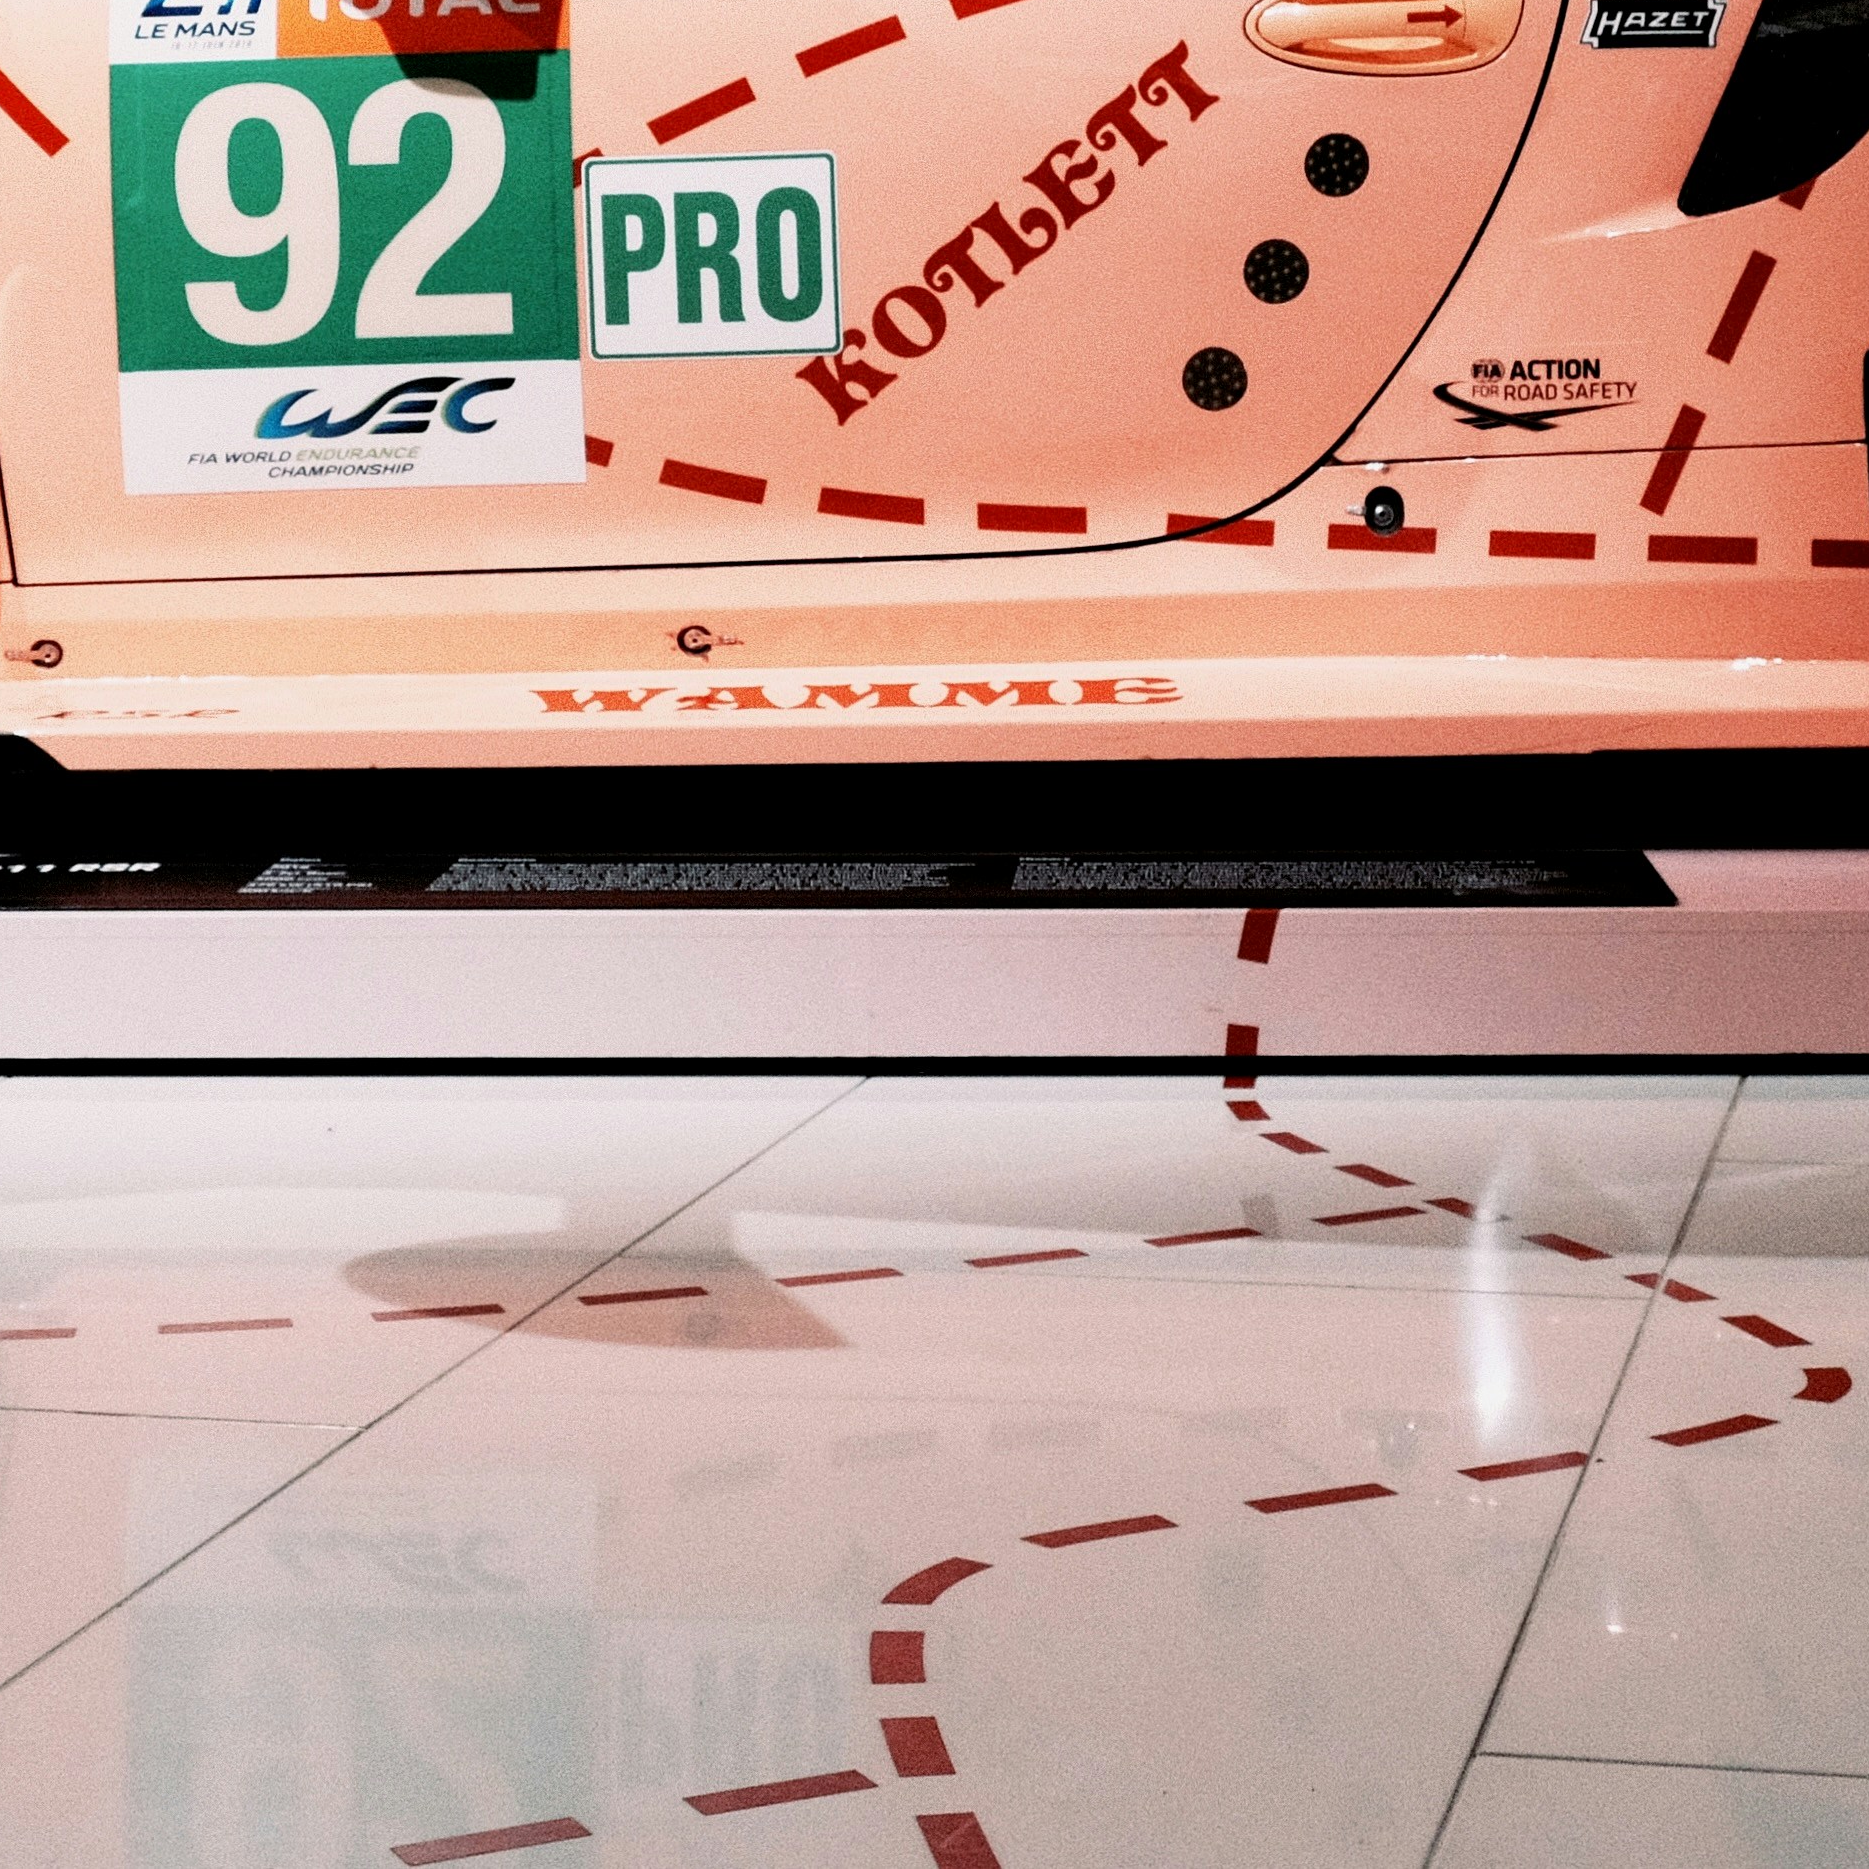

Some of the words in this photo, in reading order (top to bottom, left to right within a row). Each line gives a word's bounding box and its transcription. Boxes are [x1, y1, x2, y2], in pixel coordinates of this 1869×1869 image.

[134, 23, 169, 39] LE
[174, 20, 256, 38] MANS
[1597, 11, 1710, 36] HAZET
[172, 77, 515, 347] 92
[795, 39, 1220, 427] KOTLETT
[600, 185, 824, 327] PRO
[1472, 362, 1503, 379] FIA
[1510, 358, 1601, 381] ACTION
[1472, 384, 1499, 398] FOR
[1504, 382, 1557, 401] ROAD
[1563, 381, 1637, 401] SAFETY
[254, 376, 517, 439] WEC
[187, 452, 218, 465] FIA
[225, 450, 291, 464] WORLD
[295, 446, 421, 462] ENDURANCE
[268, 463, 414, 479] CHAMPIONSHIP
[530, 677, 1183, 713] WAMME
[69, 861, 161, 874] RSR
